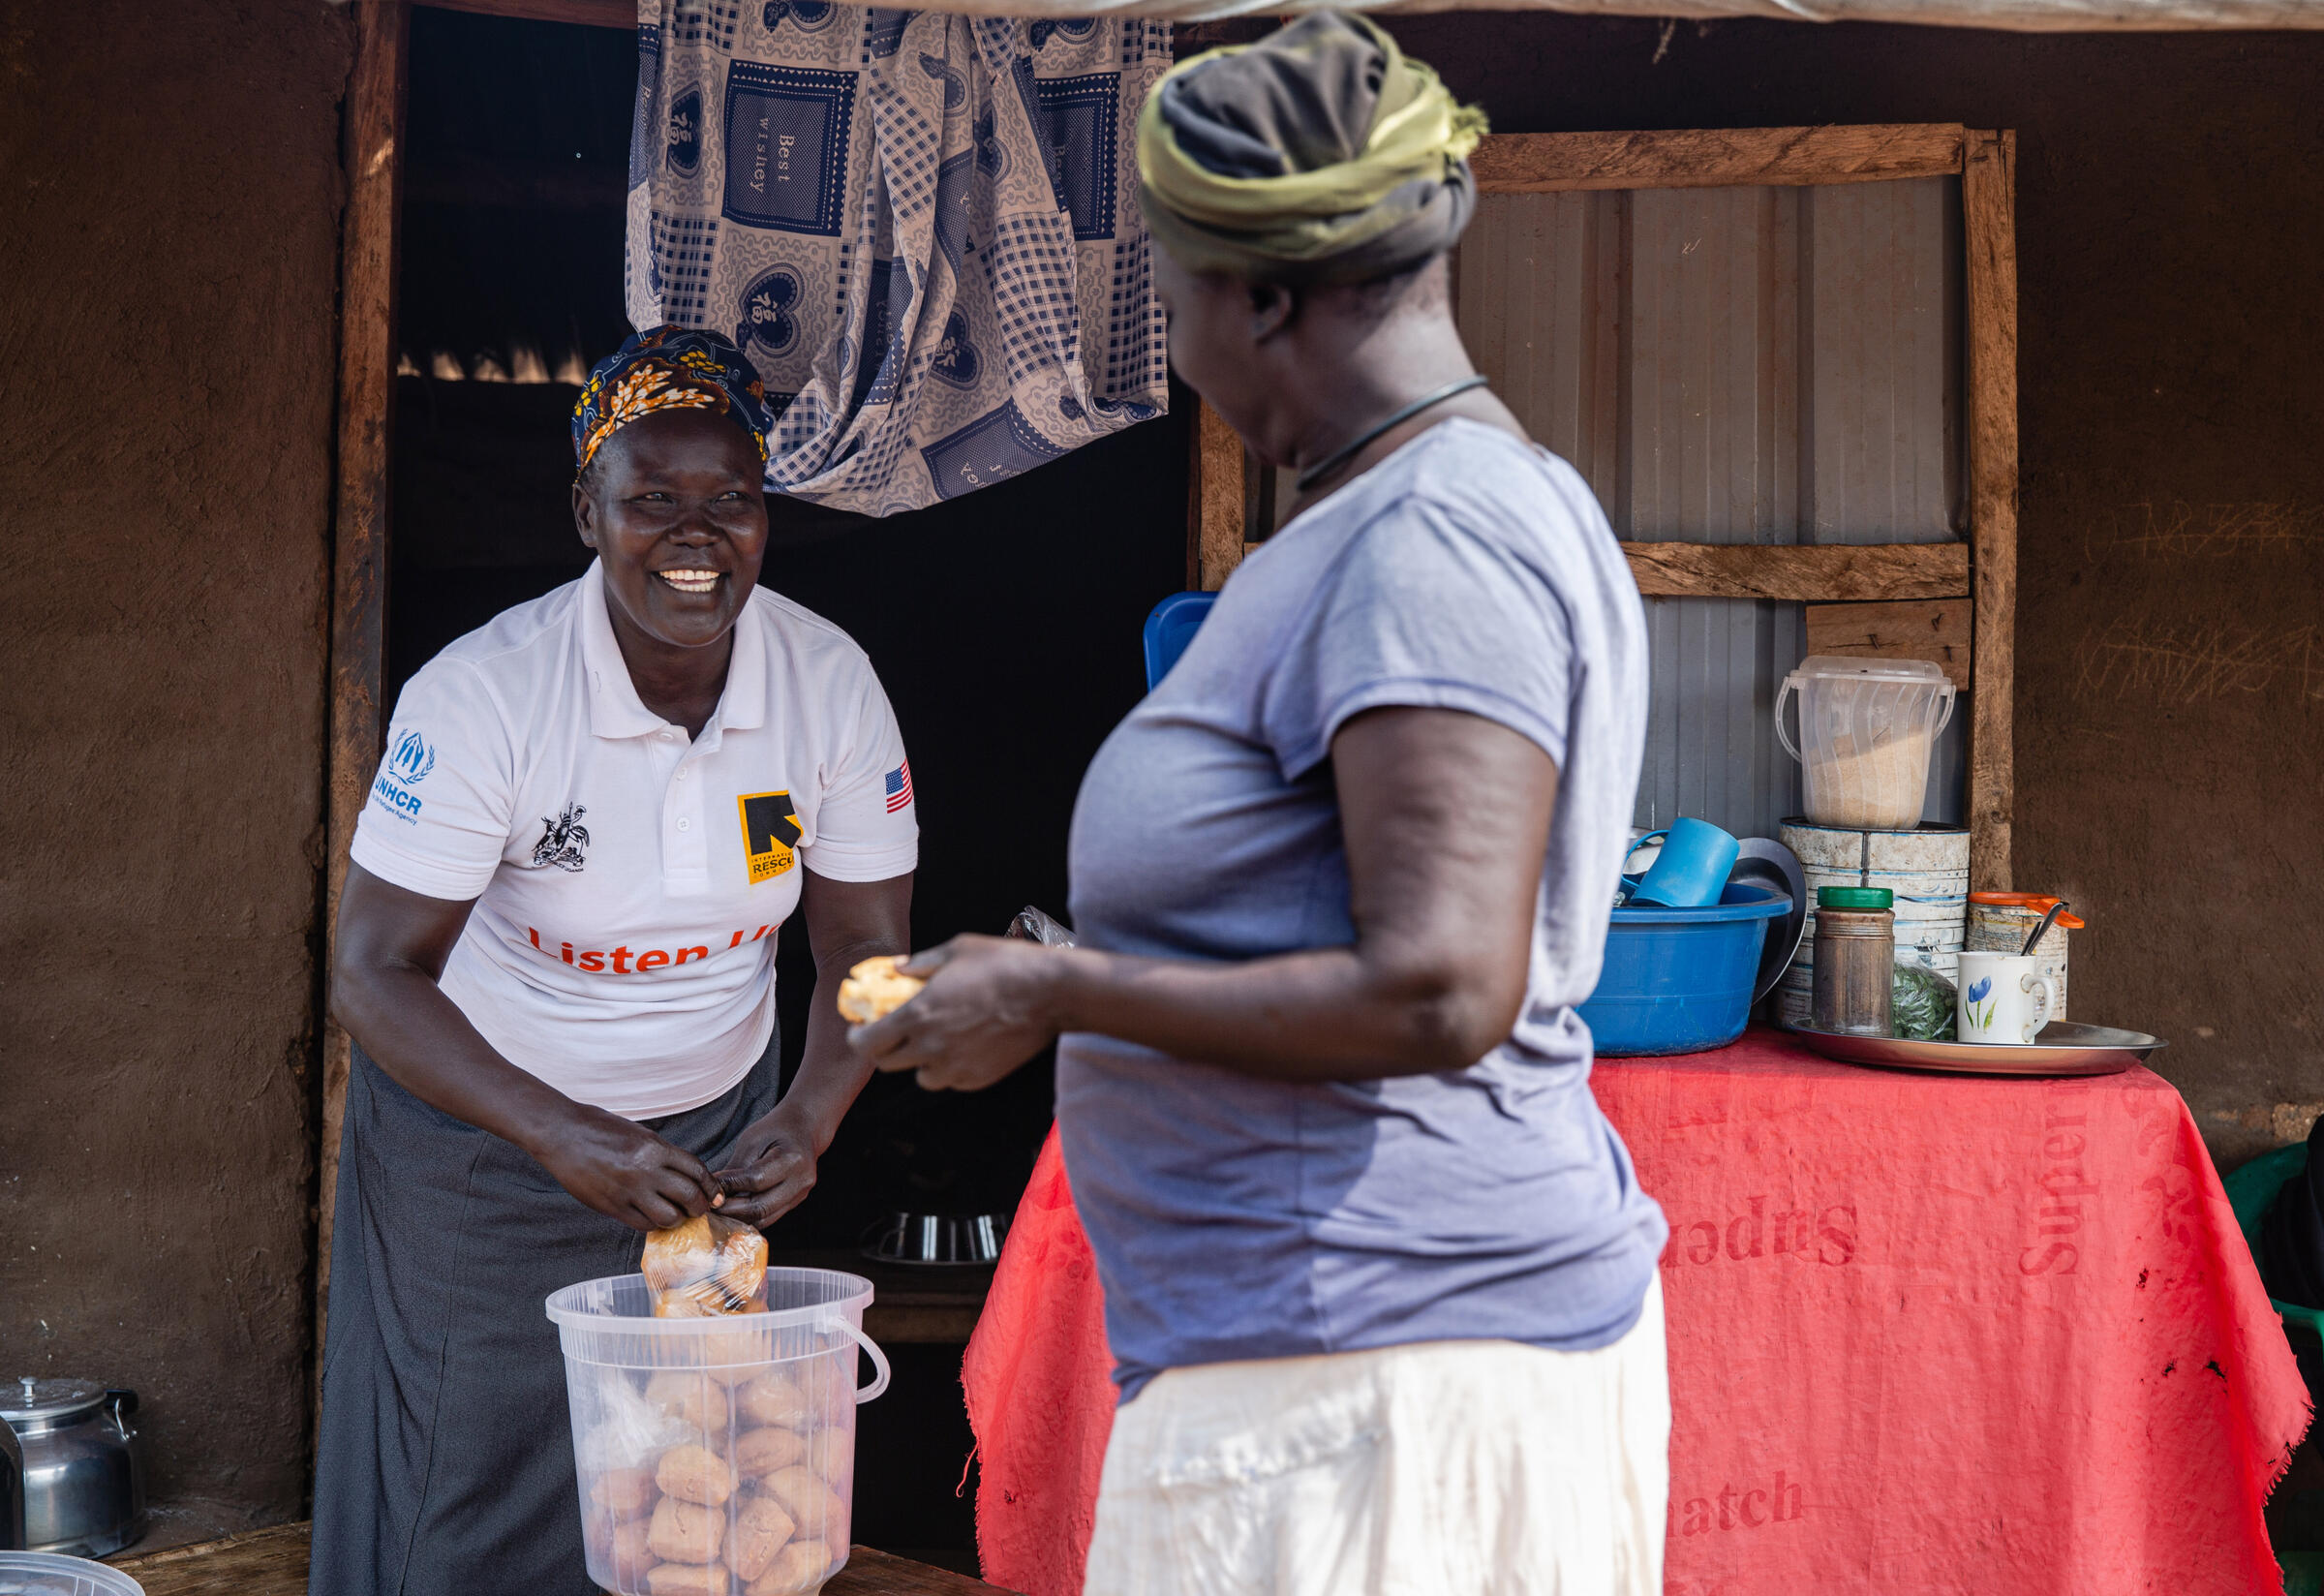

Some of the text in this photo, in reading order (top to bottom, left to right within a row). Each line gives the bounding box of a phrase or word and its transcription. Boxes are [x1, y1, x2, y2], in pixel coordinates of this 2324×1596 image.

[778, 134, 795, 182] Best
[751, 292, 778, 324] 福
[375, 773, 422, 815] UNHCR
[529, 926, 709, 974] Listen
[2017, 1083, 2100, 1276] Super
